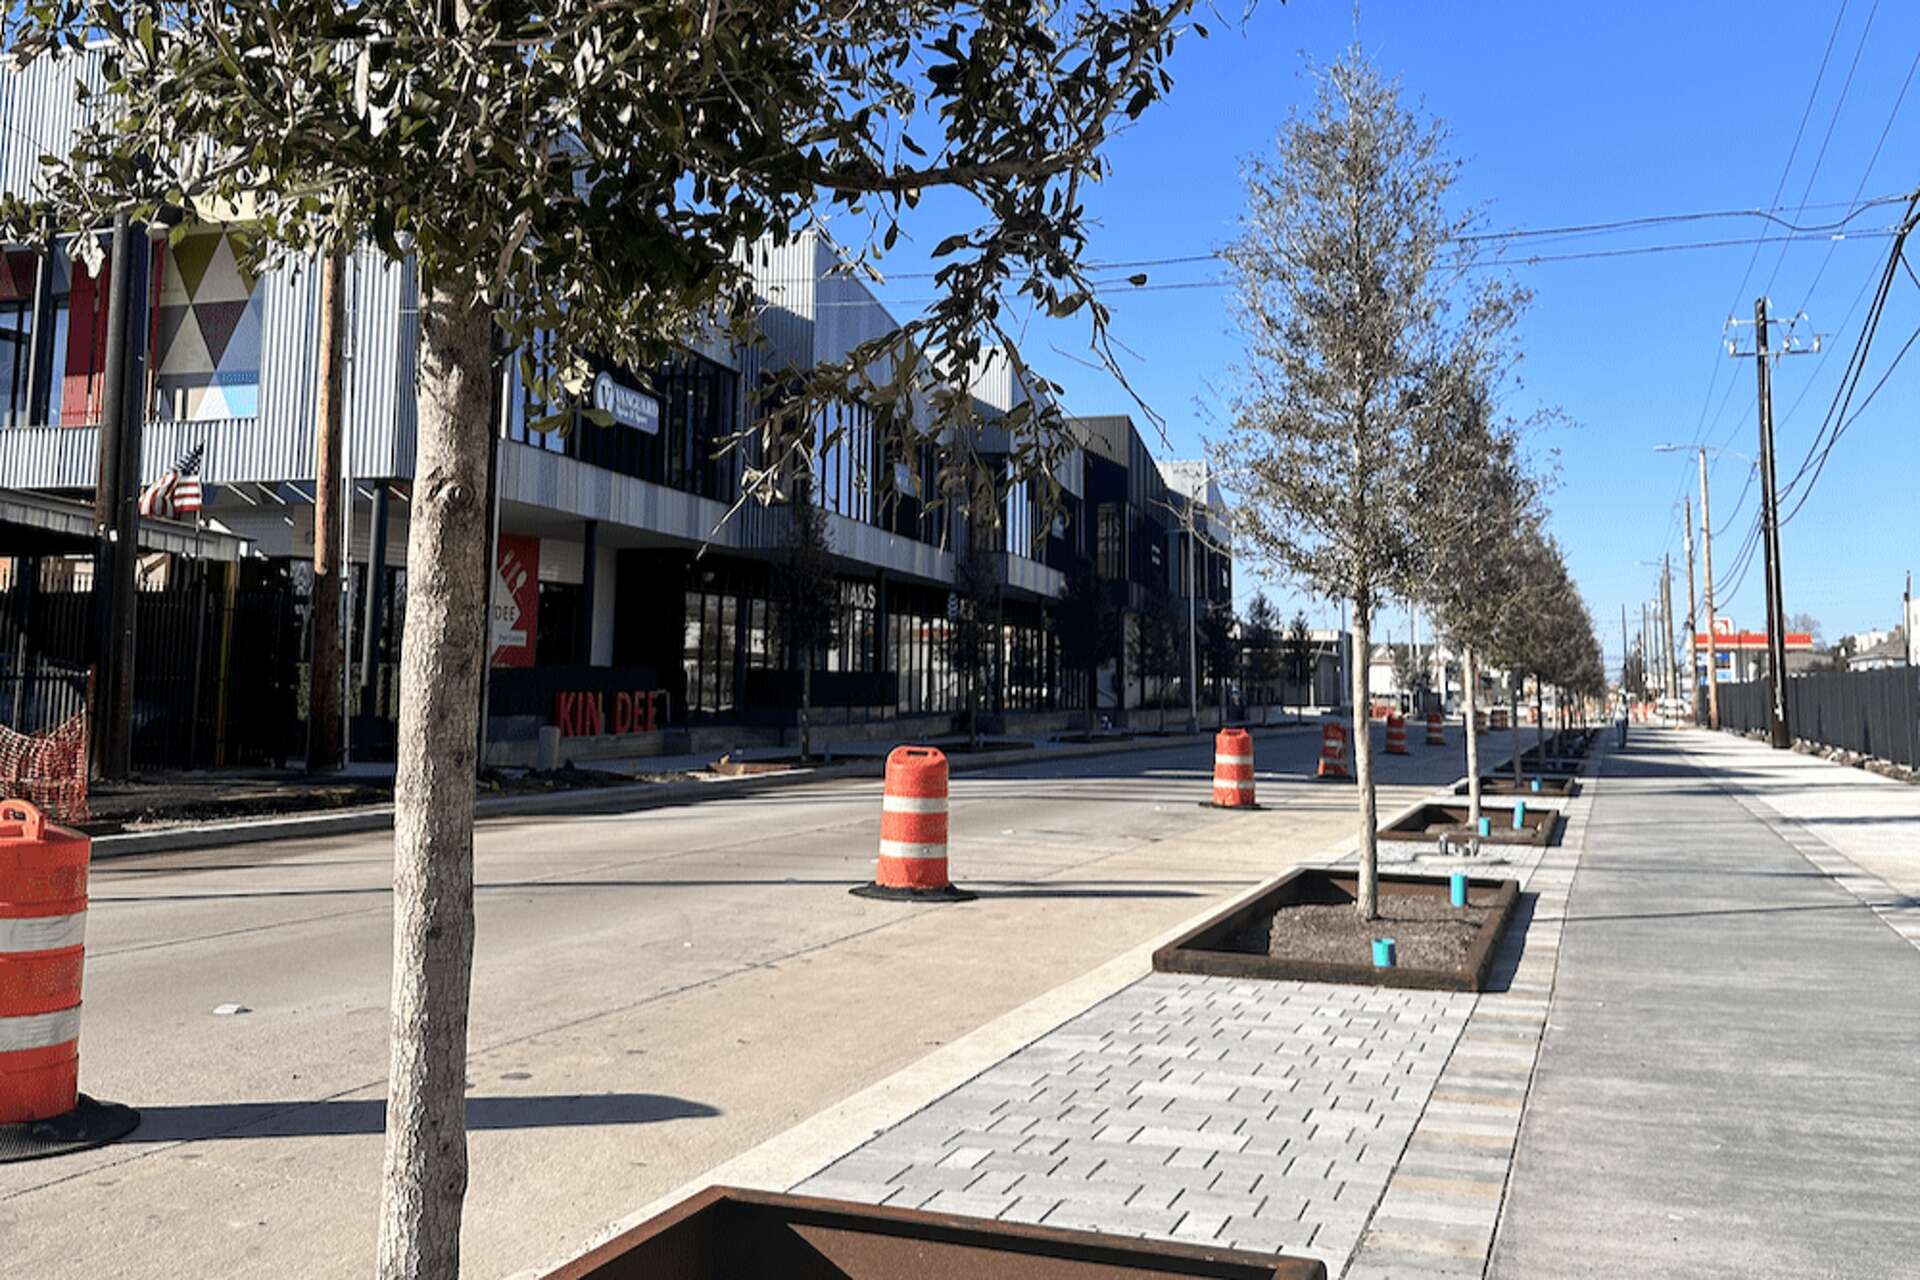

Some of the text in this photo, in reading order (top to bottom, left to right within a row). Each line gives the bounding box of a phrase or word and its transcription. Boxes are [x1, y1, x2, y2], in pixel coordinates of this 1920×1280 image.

[495, 605, 516, 621] DEE
[558, 689, 659, 737] KIN DEE
